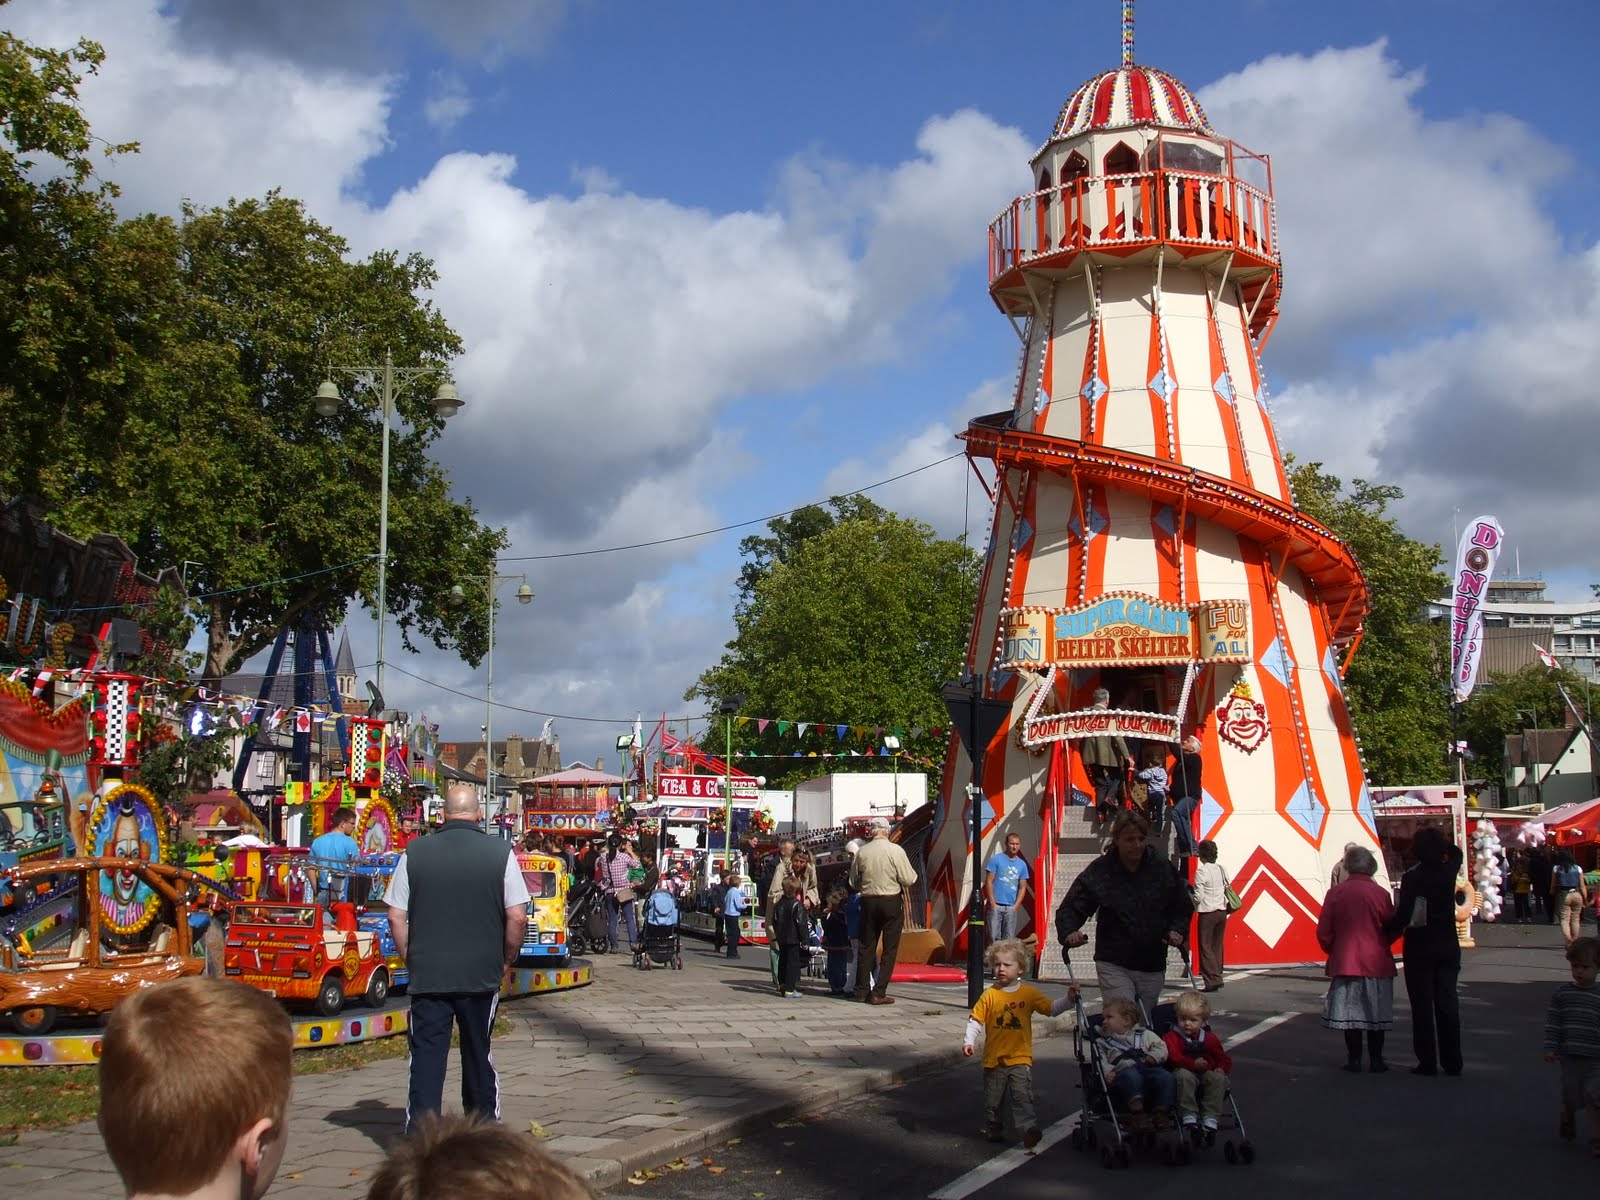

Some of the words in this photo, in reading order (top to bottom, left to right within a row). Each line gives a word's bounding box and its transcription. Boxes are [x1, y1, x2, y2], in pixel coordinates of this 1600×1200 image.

[1007, 613, 1030, 629] LL
[1055, 598, 1126, 639] SUPER
[1127, 600, 1189, 635] GIANT
[1207, 605, 1247, 631] FU
[1003, 638, 1041, 661] UN
[1056, 638, 1117, 660] HELTER
[1119, 635, 1192, 658] SKELTER
[1212, 641, 1249, 656] AL
[1064, 714, 1113, 734] FORGET
[1116, 715, 1146, 733] YOUR
[1146, 718, 1175, 736] MAT
[662, 779, 687, 795] TEA
[692, 780, 701, 795] &
[706, 780, 757, 797] COFEE
[541, 814, 597, 829] ROTO
